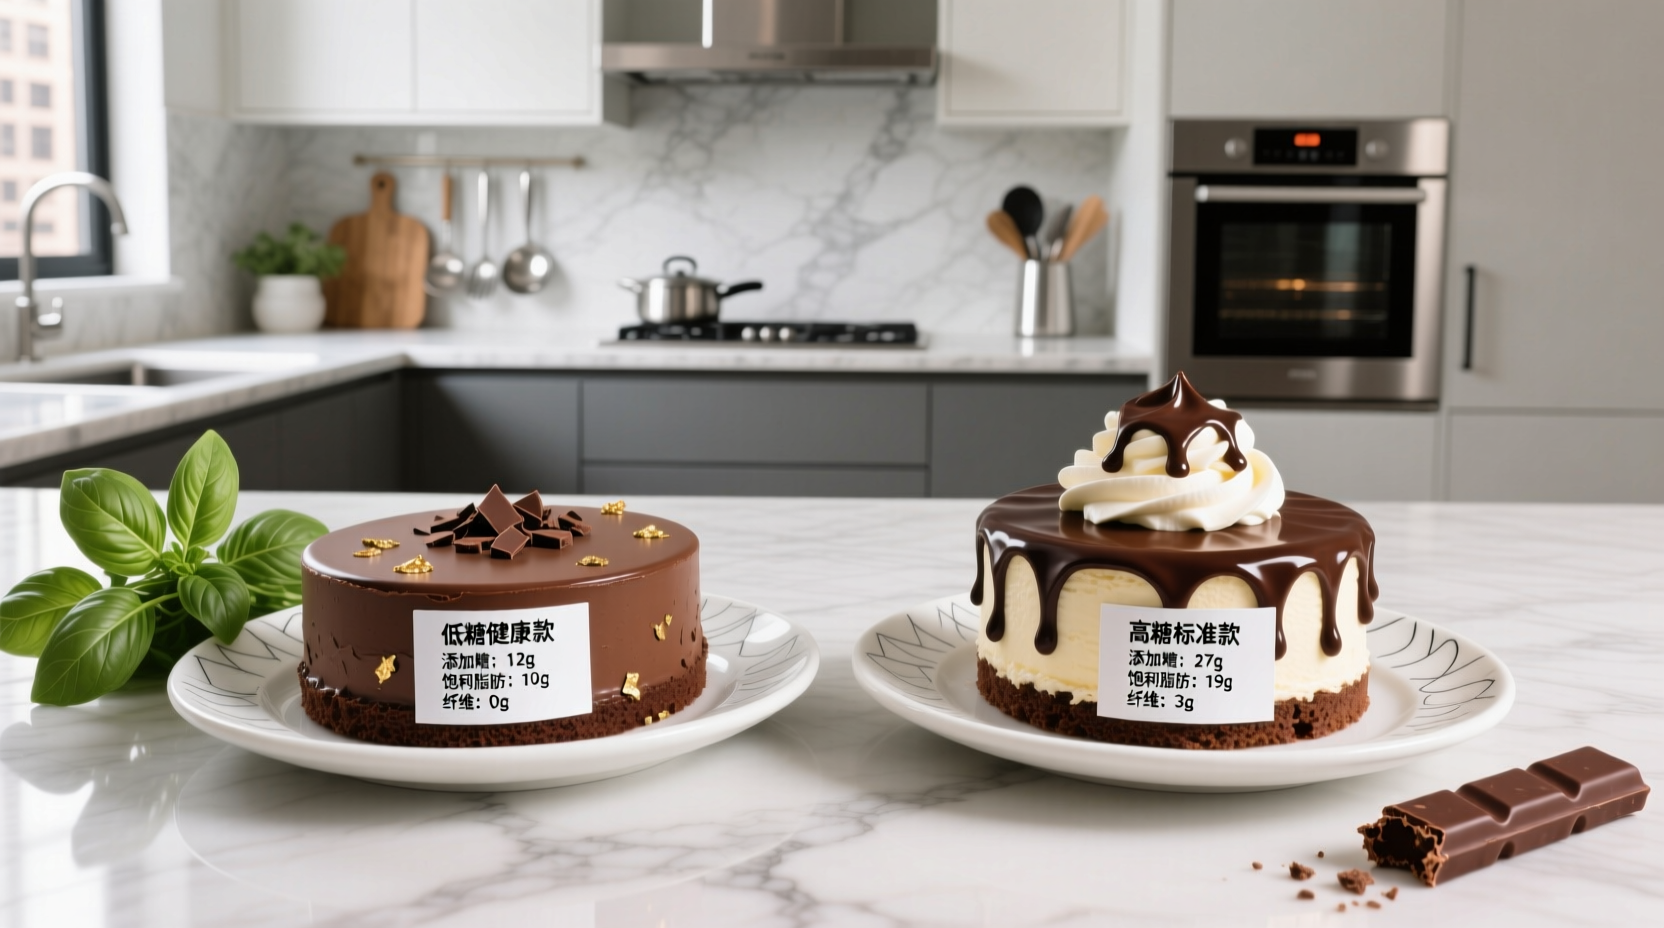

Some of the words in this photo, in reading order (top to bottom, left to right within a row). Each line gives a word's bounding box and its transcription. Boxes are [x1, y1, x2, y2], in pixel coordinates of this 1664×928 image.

[440, 618, 555, 647] 低糖健康款
[1129, 618, 1241, 646] 高糖标准款
